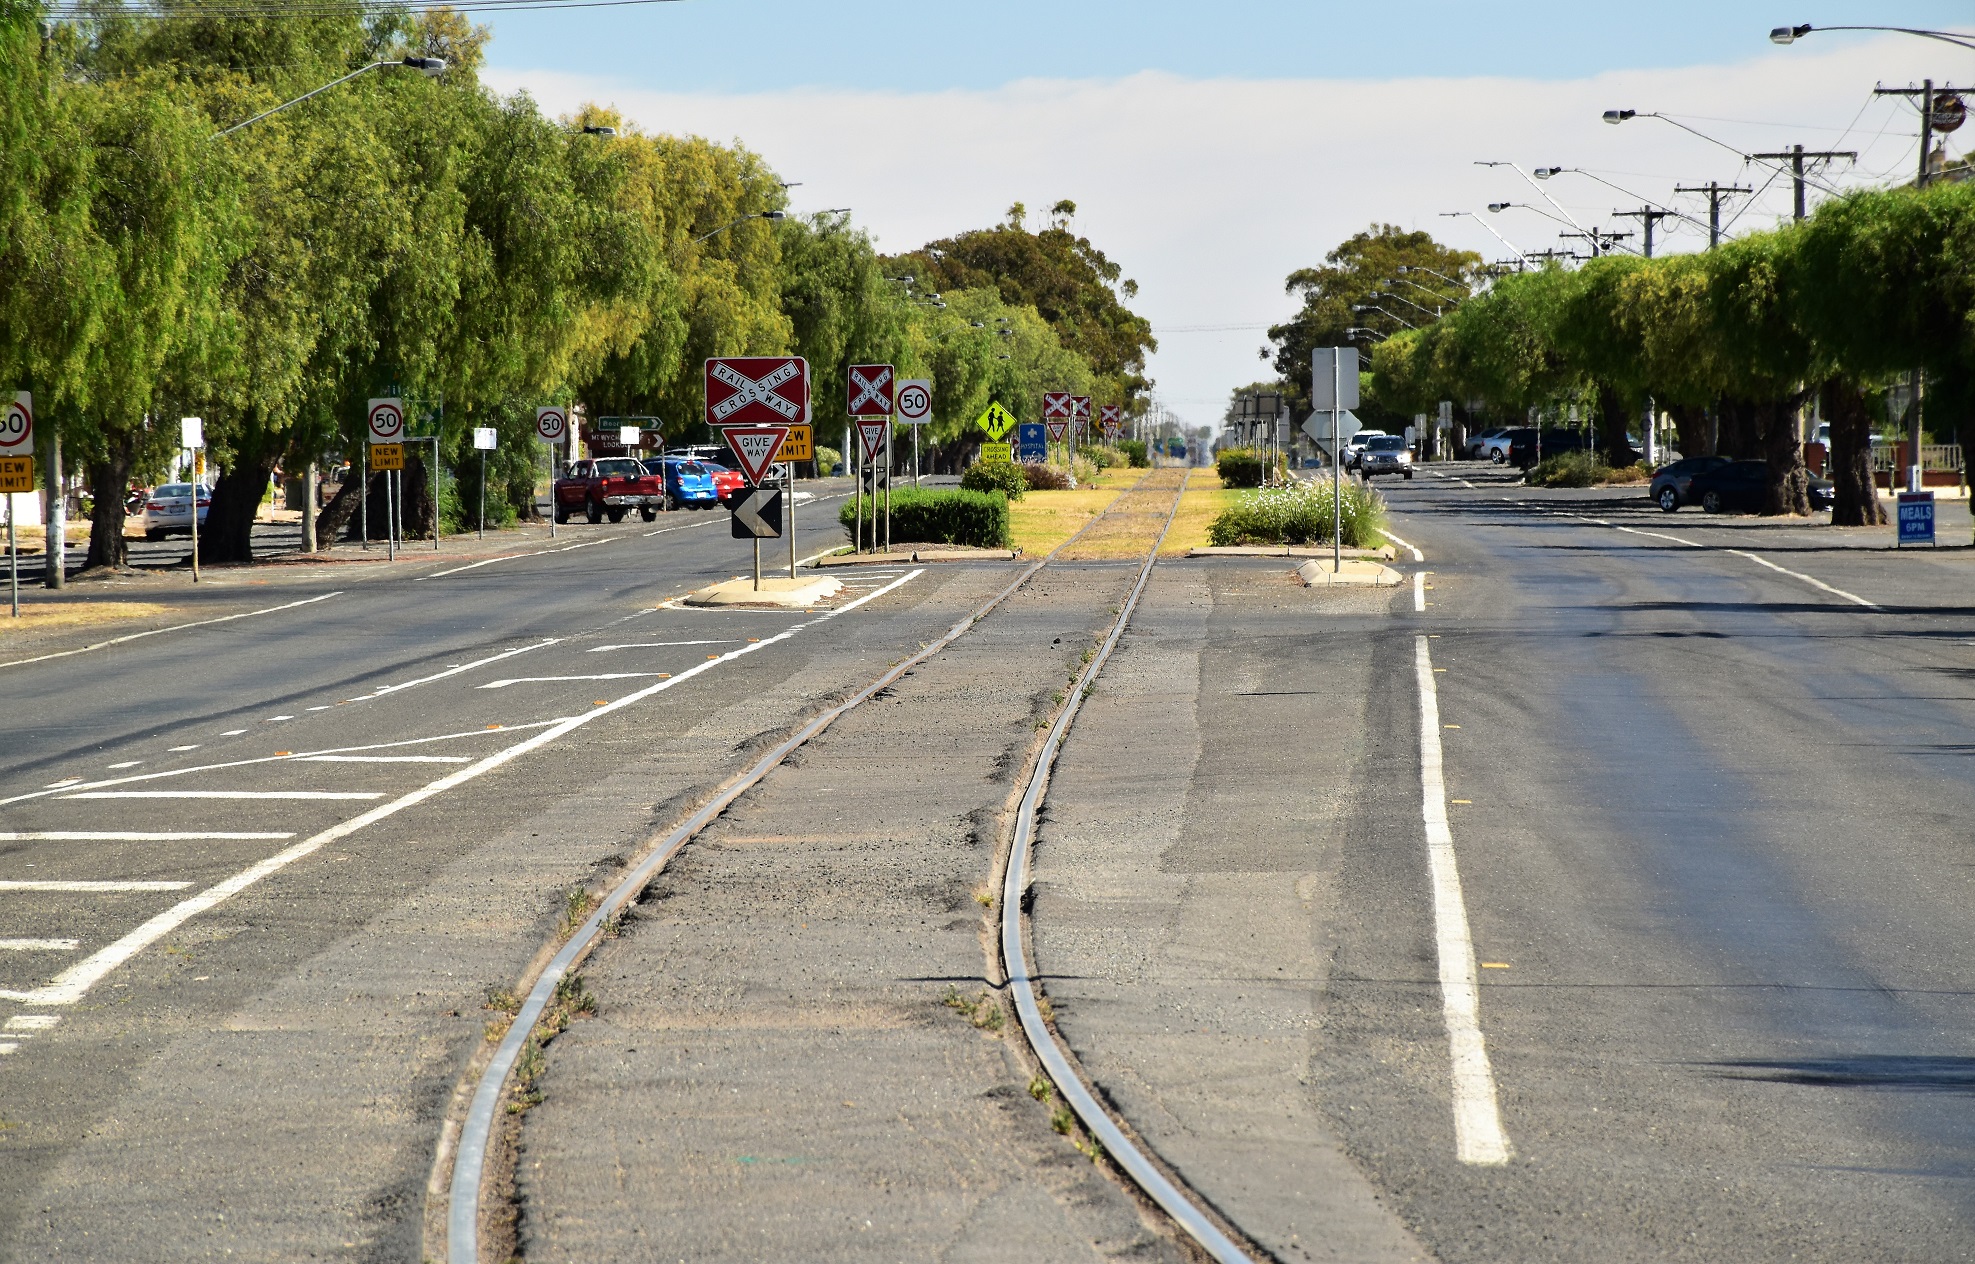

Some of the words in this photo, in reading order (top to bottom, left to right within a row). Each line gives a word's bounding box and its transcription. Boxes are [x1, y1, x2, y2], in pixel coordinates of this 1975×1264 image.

[904, 394, 925, 408] 50
[375, 413, 397, 428] 50
[542, 418, 560, 431] 50
[785, 431, 804, 441] EW
[864, 427, 879, 435] GIVE
[742, 438, 770, 447] GIVE
[375, 448, 398, 456] NEW
[747, 449, 766, 457] WAY
[374, 458, 400, 466] LIMIT
[0, 462, 25, 473] EW
[0, 477, 27, 487] IMIT
[1900, 506, 1932, 520] MEALS
[1906, 522, 1925, 532] 6PM
